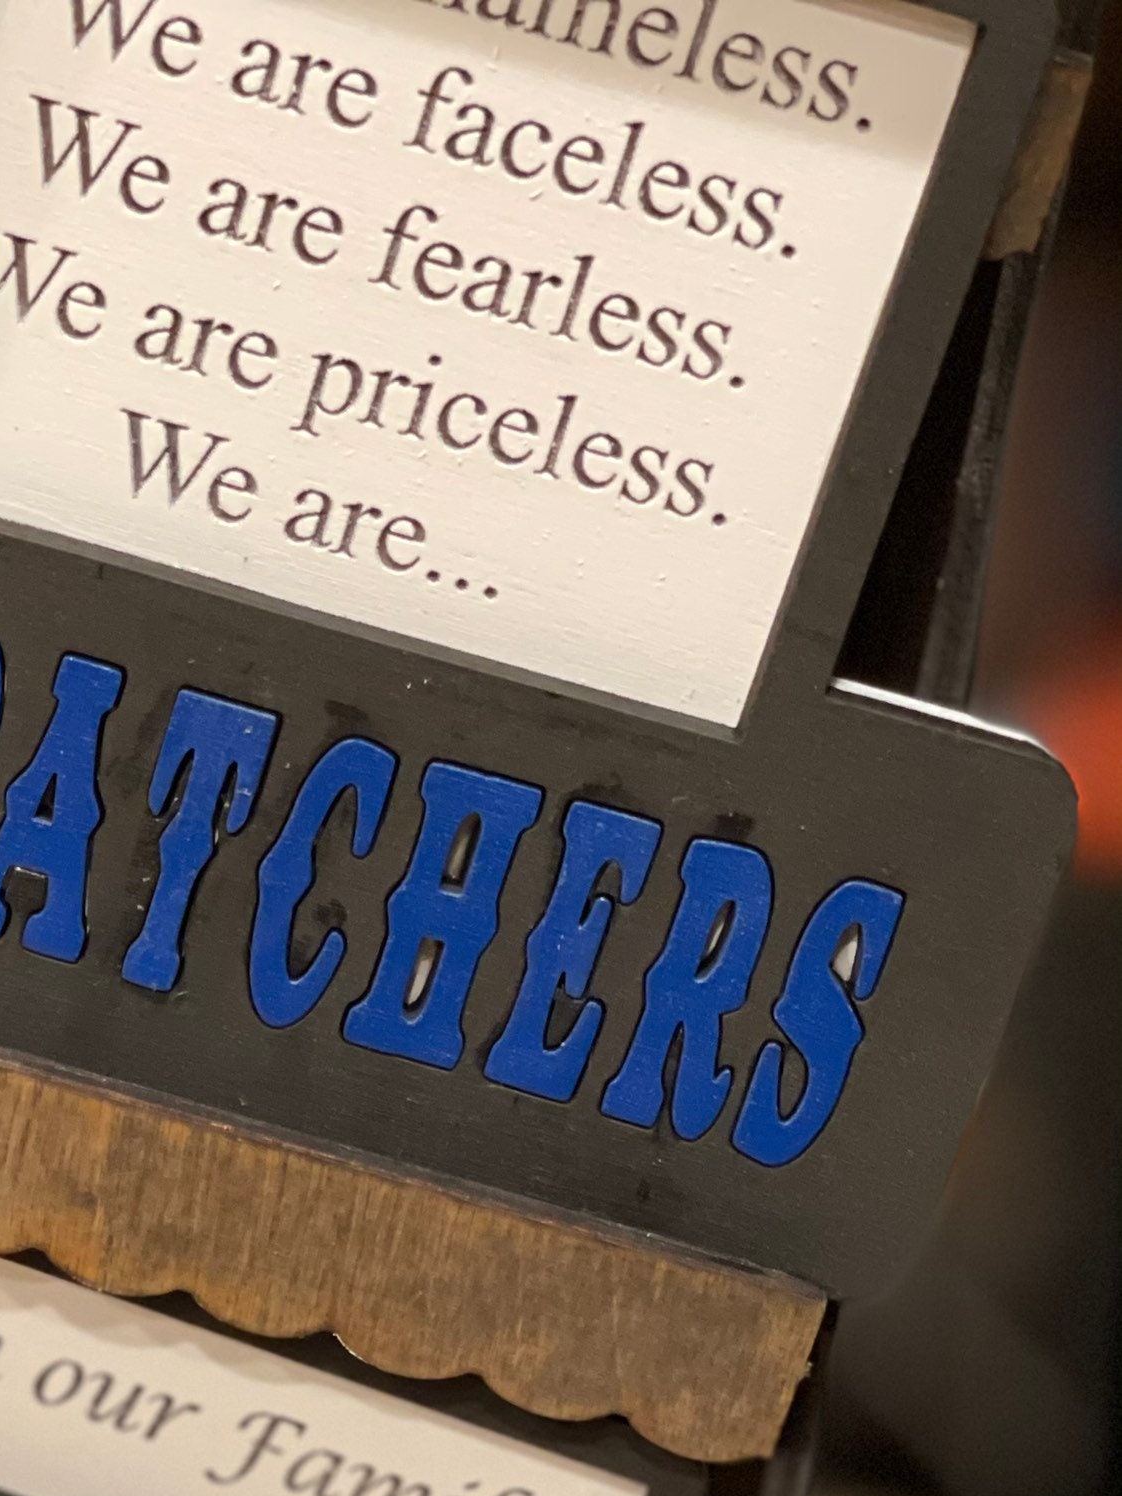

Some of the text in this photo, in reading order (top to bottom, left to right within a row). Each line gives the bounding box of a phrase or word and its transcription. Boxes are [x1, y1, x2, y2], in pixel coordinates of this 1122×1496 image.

[69, 0, 797, 258] We are faceless.
[413, 0, 872, 132] meless.
[30, 94, 745, 388] We are fearless.
[119, 408, 499, 599] We are...
[133, 303, 279, 390] are
[289, 352, 728, 527] priceless.
[31, 1357, 201, 1445] our
